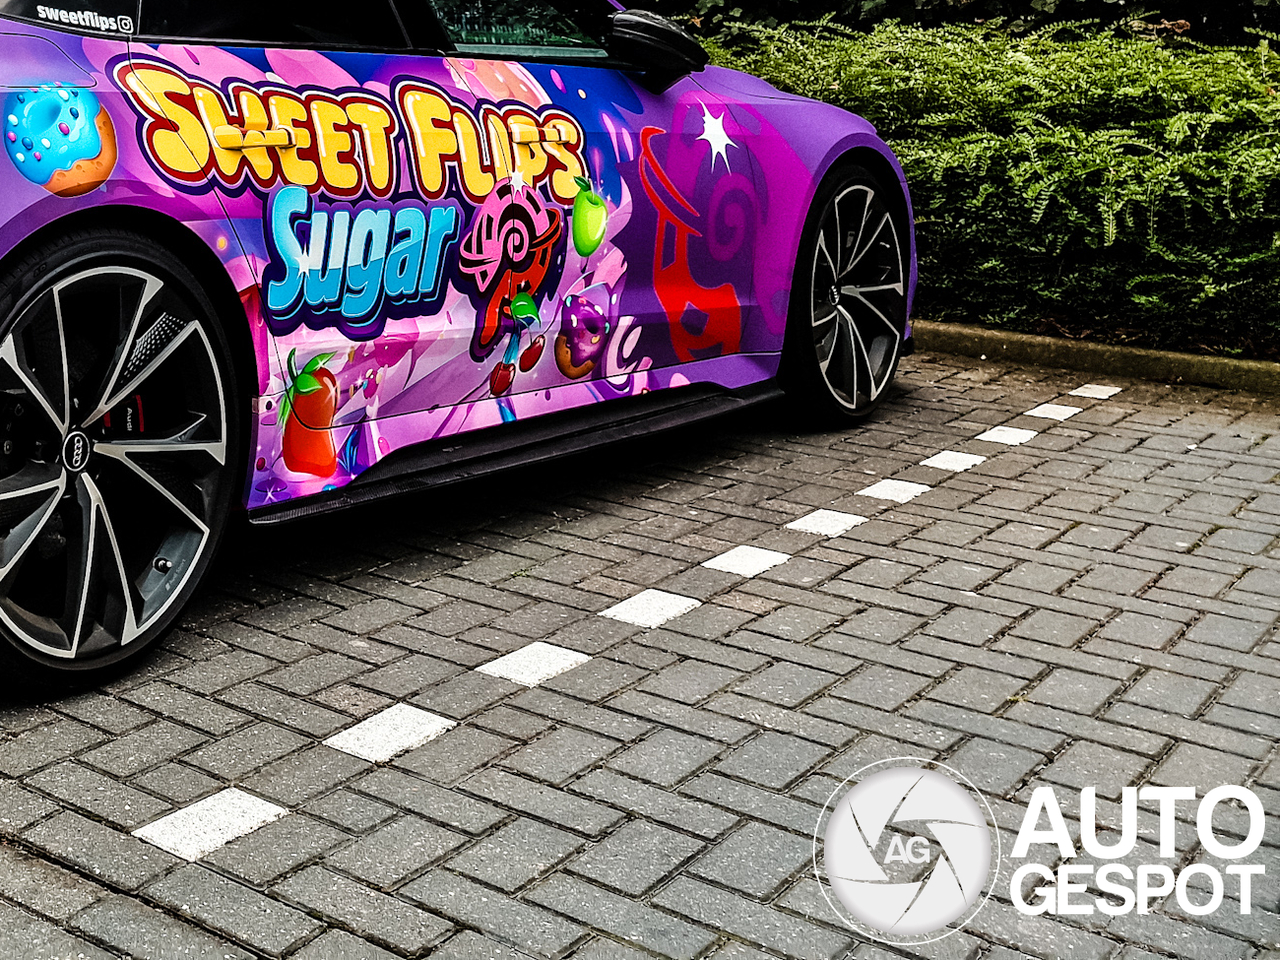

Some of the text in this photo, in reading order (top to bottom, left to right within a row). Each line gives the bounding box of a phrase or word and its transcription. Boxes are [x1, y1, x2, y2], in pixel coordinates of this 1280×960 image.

[36, 5, 117, 31] sweetflips
[119, 62, 584, 204] SWEET FLIPS
[267, 185, 458, 320] Sugar
